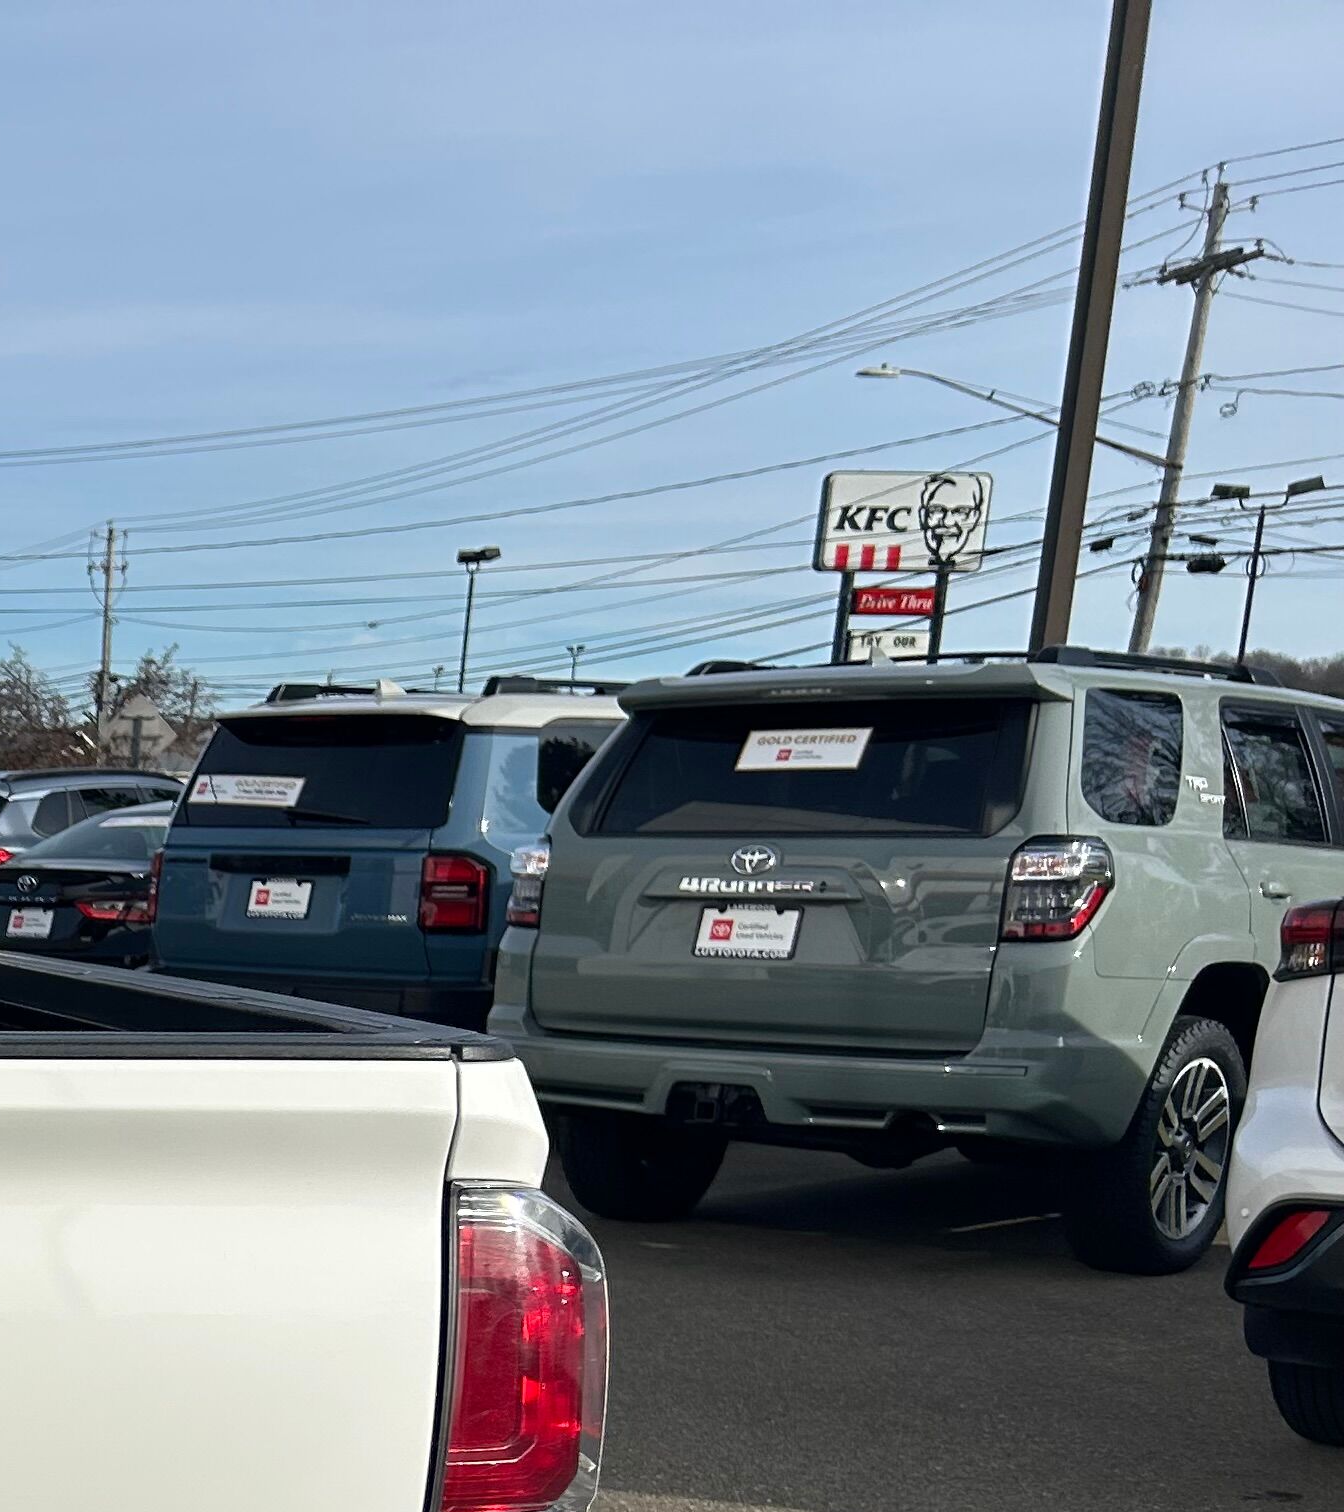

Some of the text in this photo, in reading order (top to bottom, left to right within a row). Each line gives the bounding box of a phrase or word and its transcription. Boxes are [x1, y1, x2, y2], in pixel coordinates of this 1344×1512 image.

[833, 505, 911, 532] KFC
[859, 593, 933, 610] Drive Thru
[860, 635, 917, 648] TRY OUR
[757, 734, 857, 746] GOLD CERTIFIED
